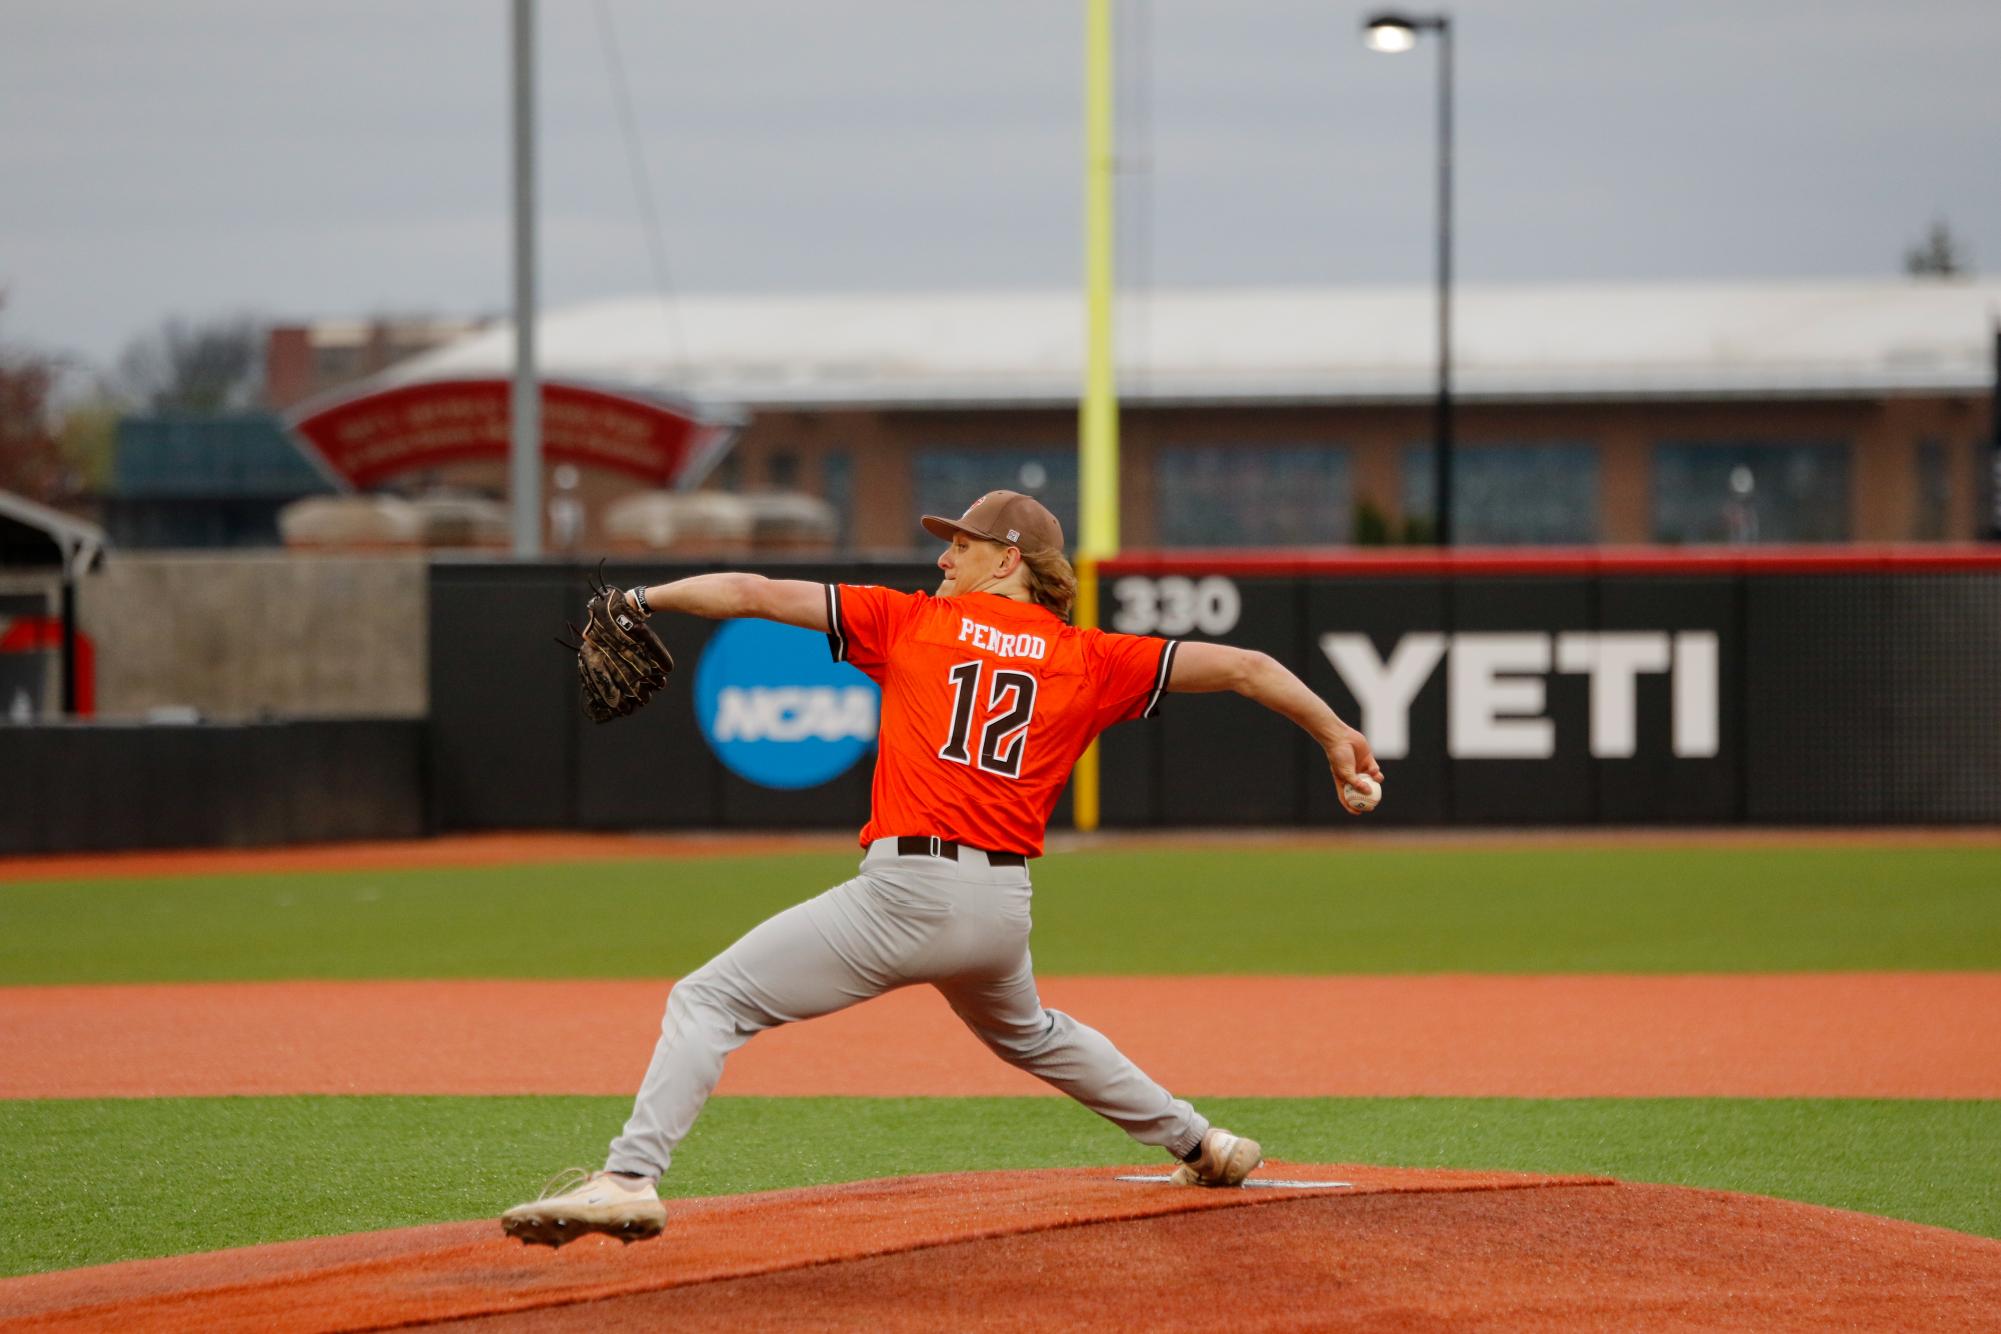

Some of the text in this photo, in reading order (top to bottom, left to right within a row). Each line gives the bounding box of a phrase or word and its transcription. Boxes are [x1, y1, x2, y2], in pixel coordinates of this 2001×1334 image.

[1113, 577, 1240, 635] 330
[958, 617, 1046, 660] PENROD
[714, 686, 877, 742] NCAA
[938, 659, 1038, 779] 12
[1321, 632, 1719, 759] YETI
